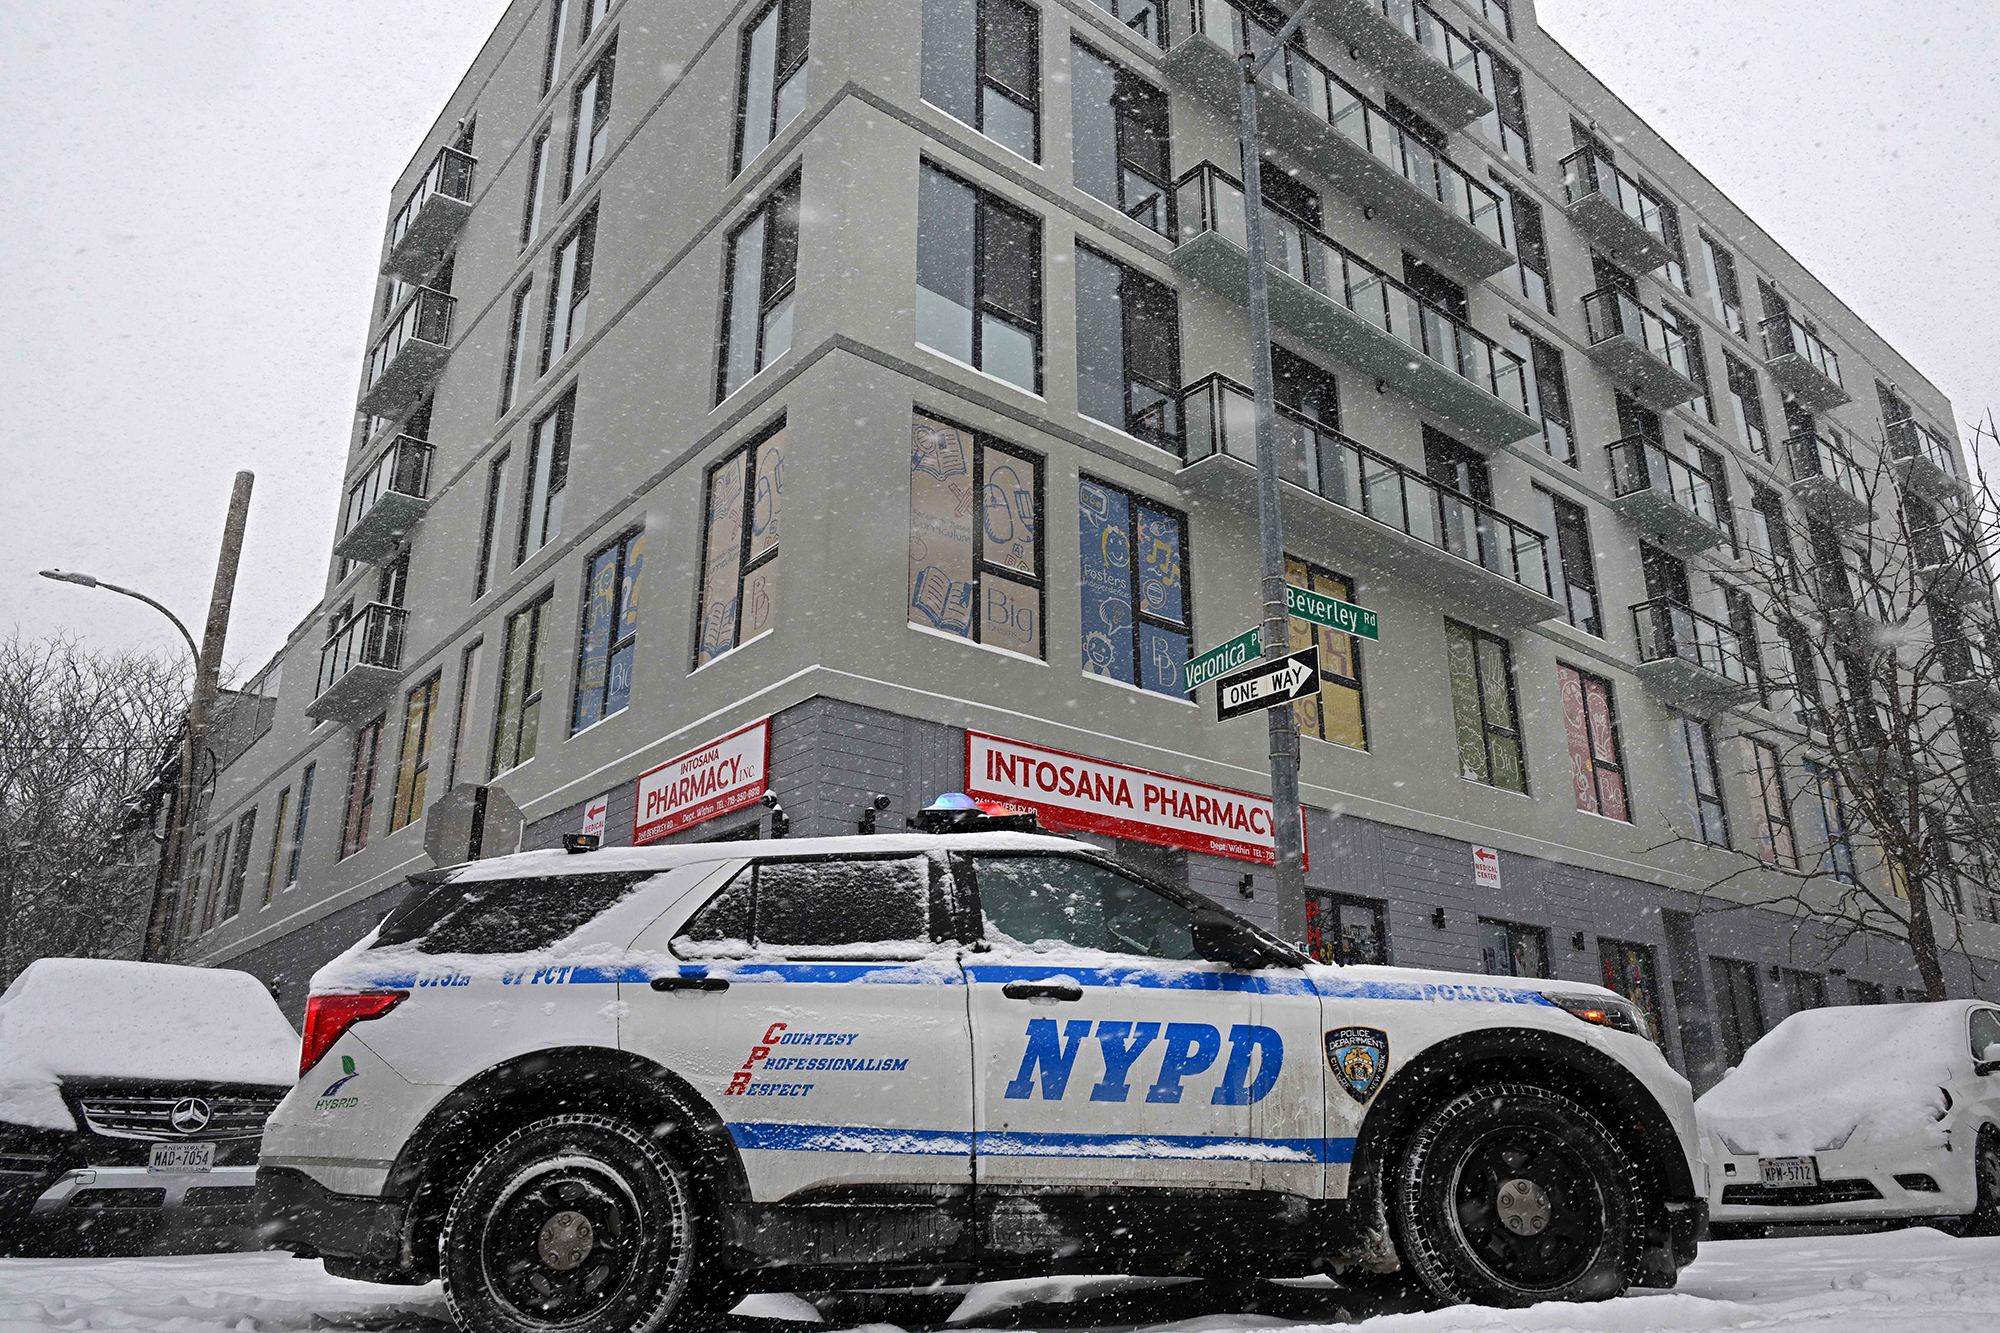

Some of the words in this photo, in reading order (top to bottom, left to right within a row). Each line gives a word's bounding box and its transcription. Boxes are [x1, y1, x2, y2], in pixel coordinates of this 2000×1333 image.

[1084, 564, 1126, 589] Fosters
[988, 587, 1033, 643] Big
[1286, 588, 1359, 632] Beverley
[1364, 612, 1376, 626] Rd
[1186, 643, 1246, 688] Veronica
[1230, 681, 1259, 704] ONE
[1271, 666, 1303, 692] WAY
[680, 748, 719, 775] INTOSANA
[646, 753, 742, 819] PHARMACY
[986, 749, 1134, 810] INTOSANA
[1143, 783, 1275, 837] PHARMACY
[1475, 863, 1498, 873] MEDICAL
[1477, 871, 1497, 880] CENTER
[531, 966, 571, 985] PCT
[1423, 984, 1514, 1003] POLICE
[762, 1022, 859, 1046] COURTESY
[1329, 1036, 1385, 1050] DEPARTMENT
[1340, 1029, 1370, 1038] POLICE
[742, 1046, 909, 1071] PROFESSIONALISM
[1004, 1018, 1284, 1106] NYPD
[1330, 1057, 1344, 1078] CITY
[1378, 1054, 1386, 1073] YORK
[723, 1072, 814, 1097] RESPECT
[1369, 1074, 1381, 1091] NEW
[314, 1097, 359, 1110] HYBRID
